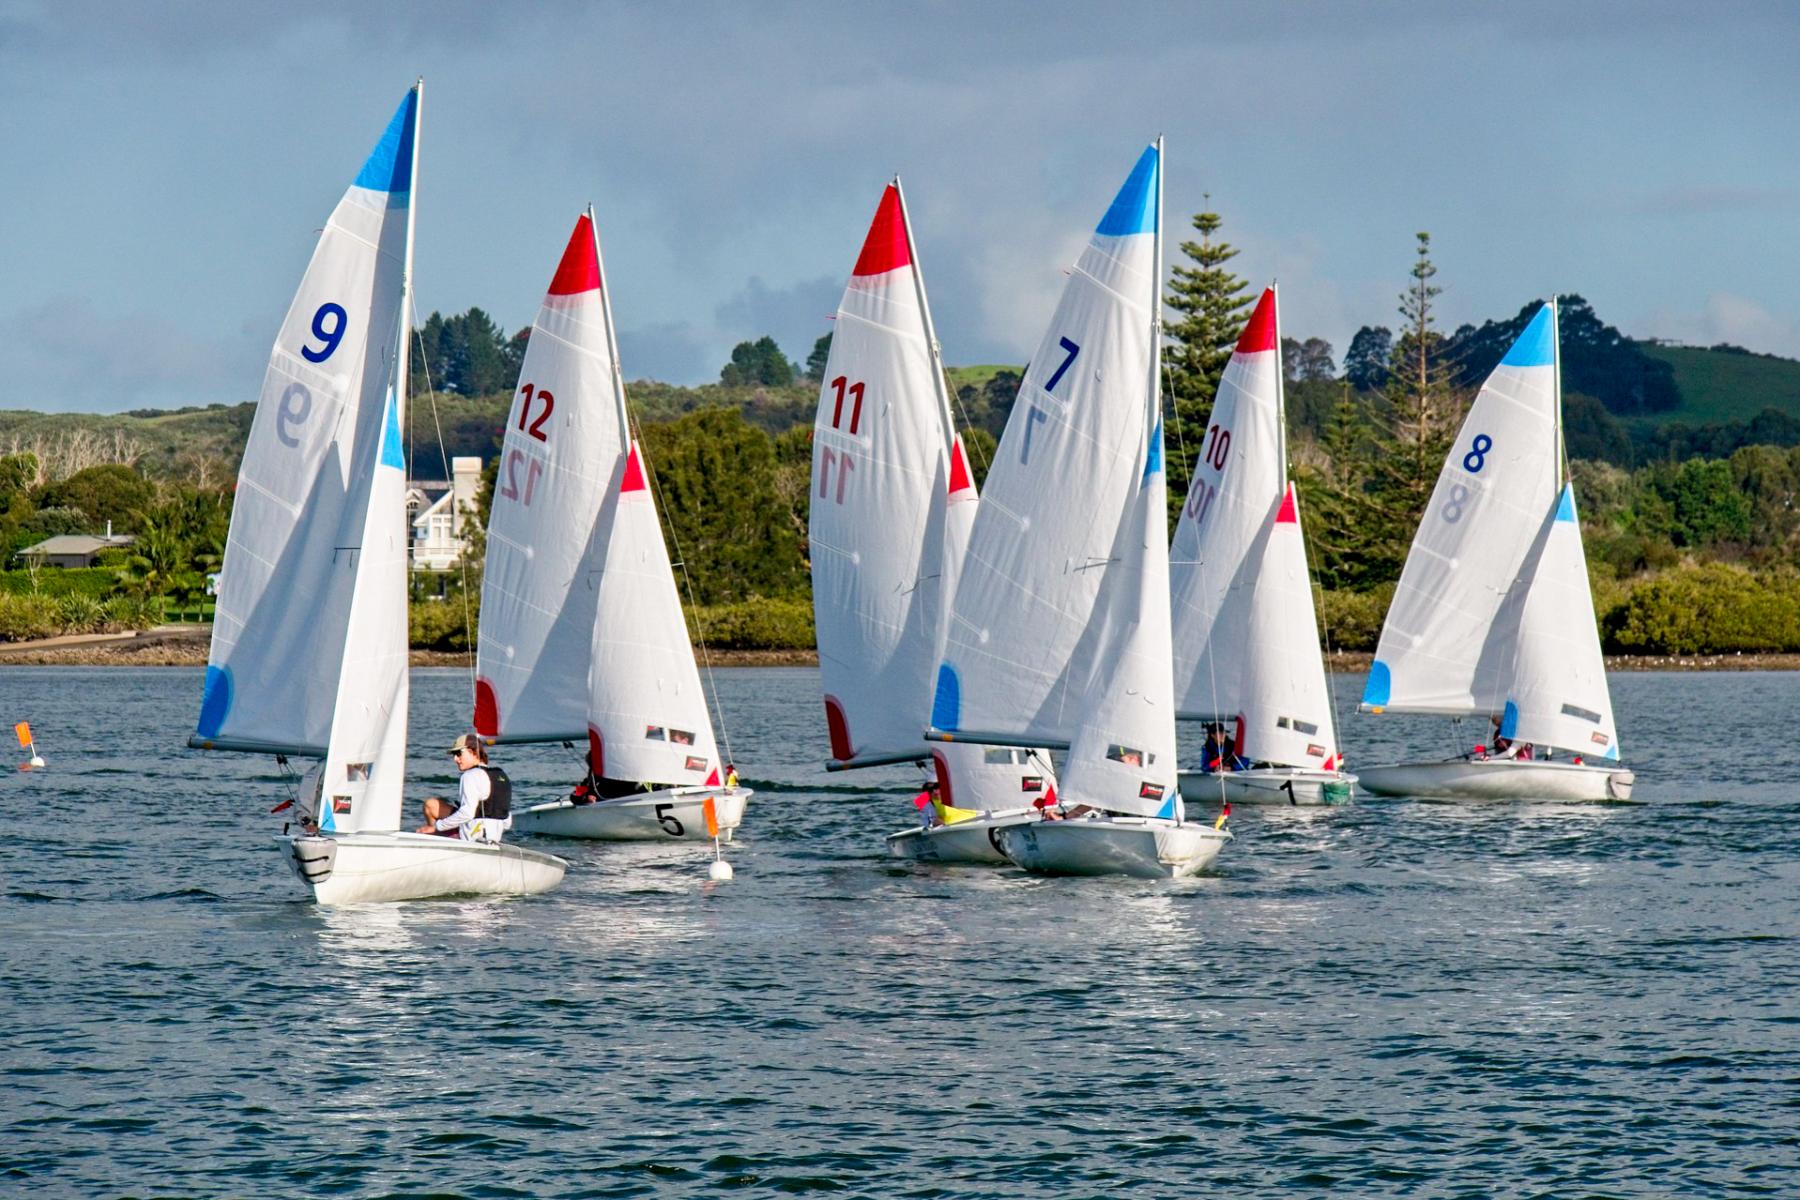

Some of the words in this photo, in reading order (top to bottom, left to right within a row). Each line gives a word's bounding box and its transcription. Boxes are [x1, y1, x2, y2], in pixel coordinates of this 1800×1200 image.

[301, 302, 348, 364] 9
[1044, 335, 1080, 393] 7
[518, 382, 555, 443] 12
[831, 375, 865, 435] 11
[1205, 424, 1232, 472] 10
[1463, 433, 1493, 473] 8
[655, 803, 685, 836] 5
[1280, 780, 1297, 806] 1
